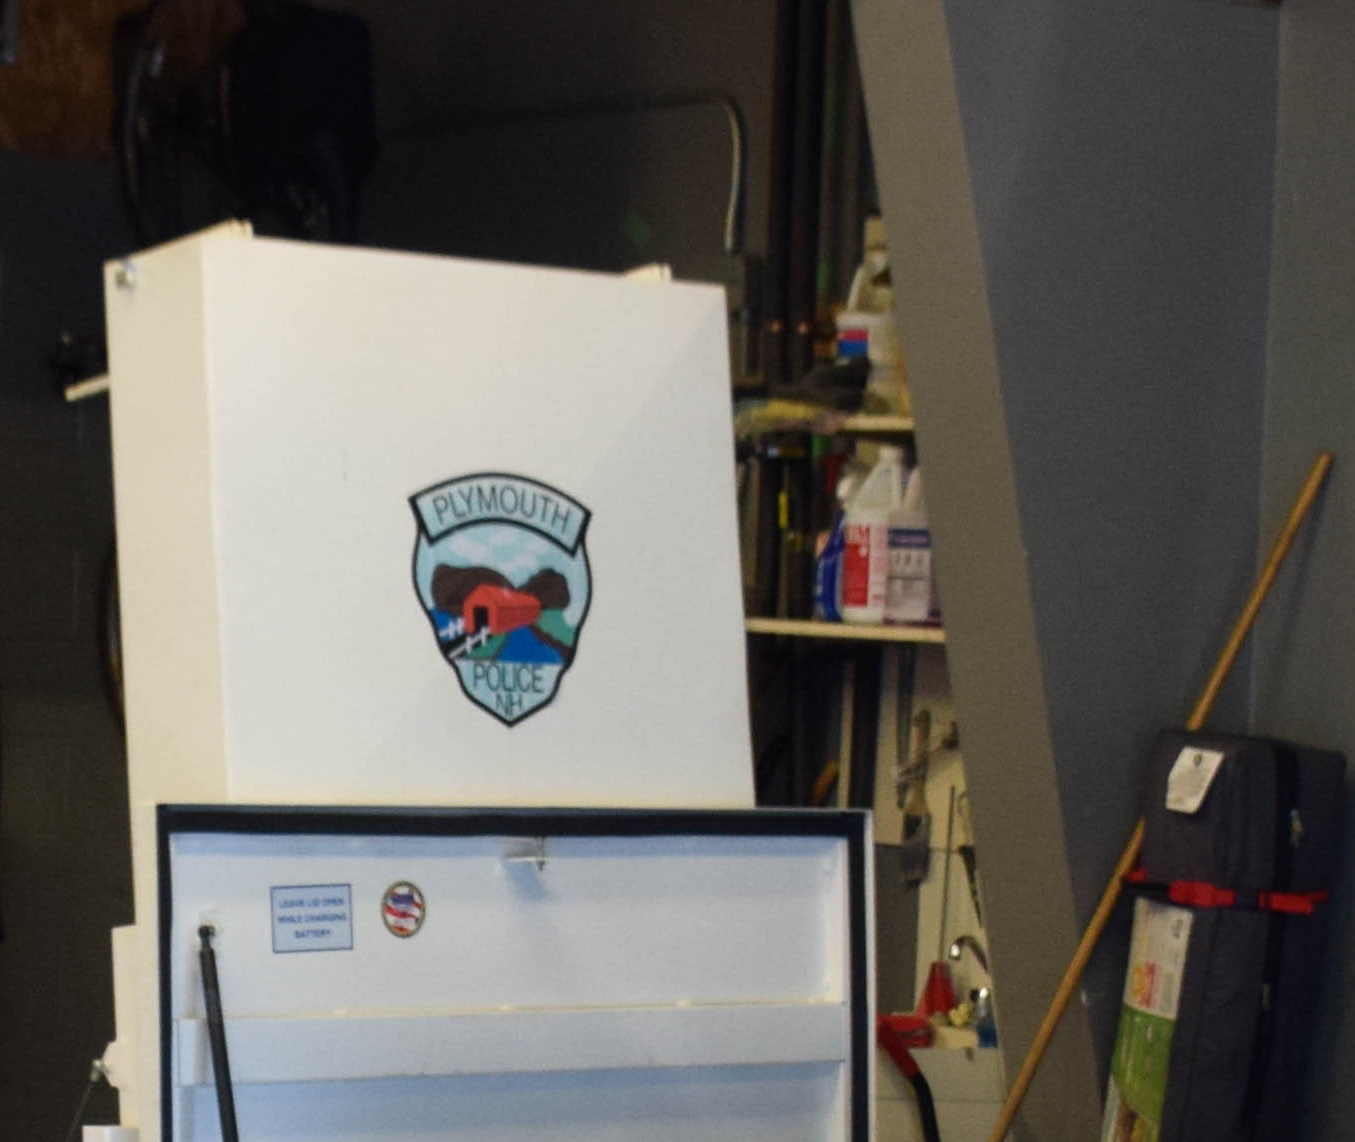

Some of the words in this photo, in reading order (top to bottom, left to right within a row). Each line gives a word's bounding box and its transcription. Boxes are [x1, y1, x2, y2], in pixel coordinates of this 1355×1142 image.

[432, 485, 572, 534] PLYMOUTH
[473, 664, 544, 693] POLICE
[495, 694, 523, 717] NH
